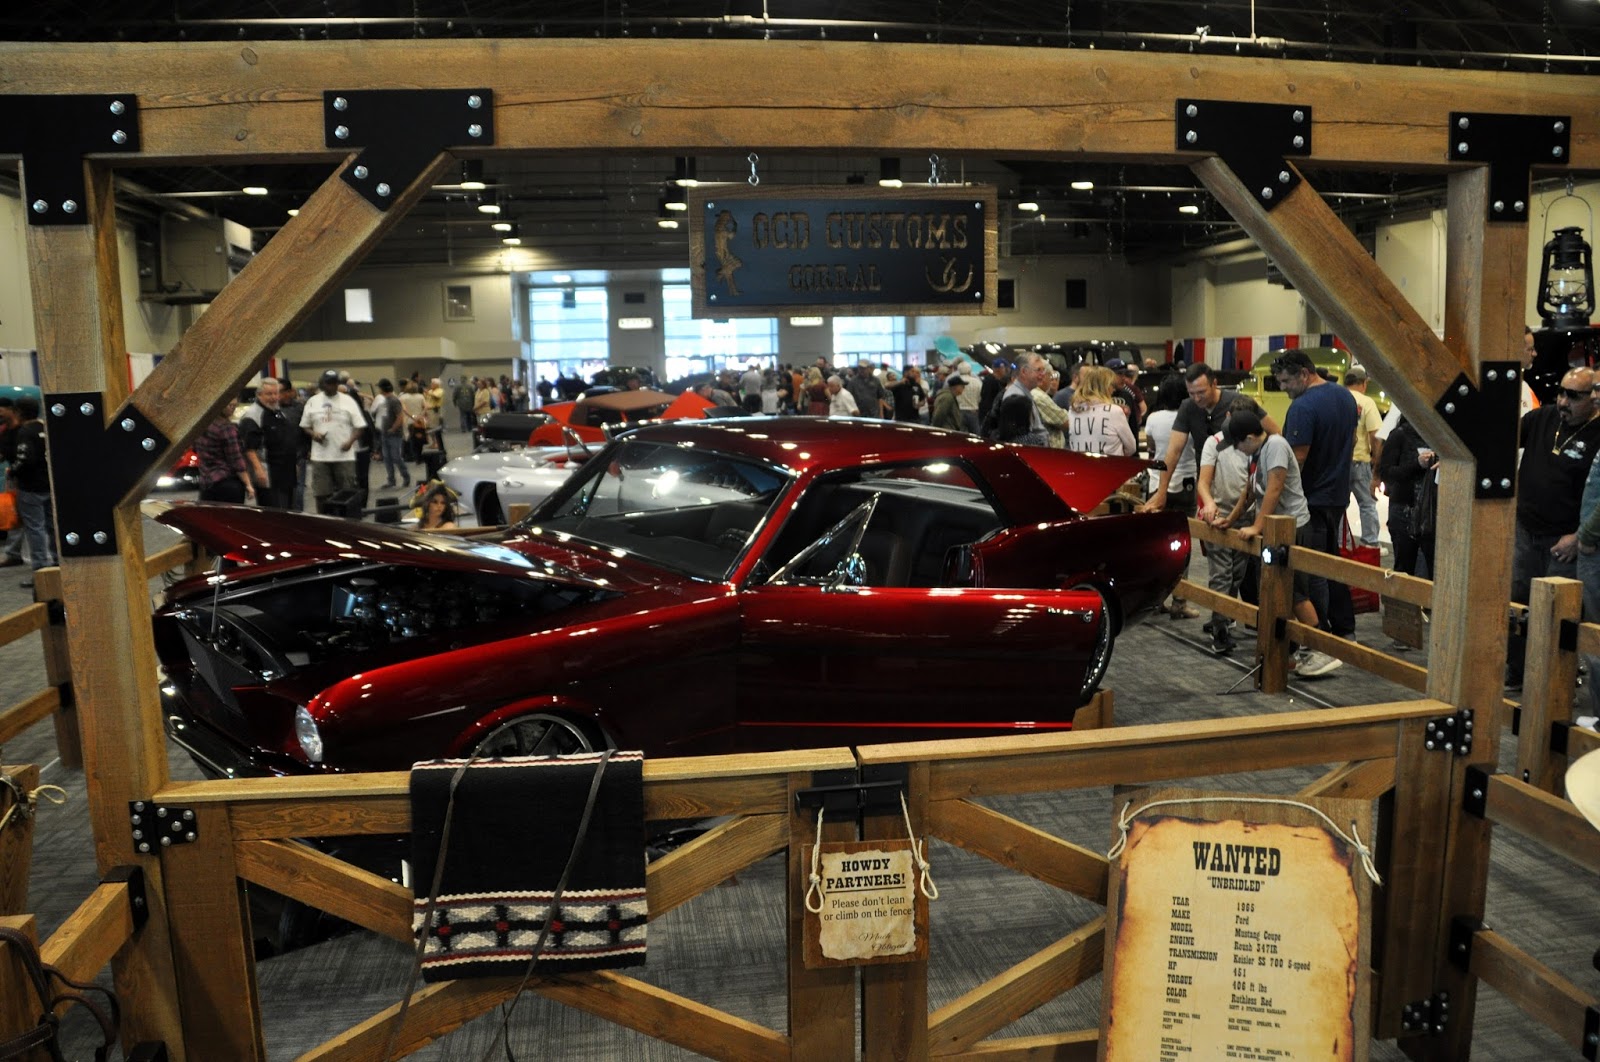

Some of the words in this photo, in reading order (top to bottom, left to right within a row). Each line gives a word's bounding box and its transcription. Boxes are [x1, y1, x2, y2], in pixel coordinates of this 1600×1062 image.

[752, 212, 810, 249] OCD
[825, 212, 968, 249] CUSTOMS
[788, 263, 882, 293] CORRAL
[1069, 417, 1109, 436] OVE
[841, 858, 890, 872] HOWDY
[1193, 841, 1281, 876] WANTED
[826, 873, 905, 889] PARTNERS!
[1207, 876, 1265, 892] "UNBRIDLED"
[832, 899, 860, 908] Please
[862, 897, 884, 907] don't
[887, 895, 905, 905] lean
[1172, 896, 1190, 906] YEAR
[1237, 902, 1255, 912] 1965
[835, 909, 859, 920] climb
[874, 908, 888, 917] the
[890, 907, 912, 916] fence
[1171, 908, 1191, 919] MAKE
[1235, 915, 1249, 925] Ford
[1170, 922, 1193, 933] MODEL
[1169, 935, 1195, 946] ENGINE
[1234, 927, 1260, 941] Mustang
[1263, 930, 1281, 943] Coupe
[1169, 947, 1218, 961] TRANSMISSION
[1168, 960, 1178, 971] HP
[1232, 967, 1246, 977] 451
[1167, 973, 1193, 985] TORQUE
[1166, 986, 1187, 998] COLOR
[1231, 993, 1257, 1006] Ruthless
[1260, 996, 1272, 1007] Red
